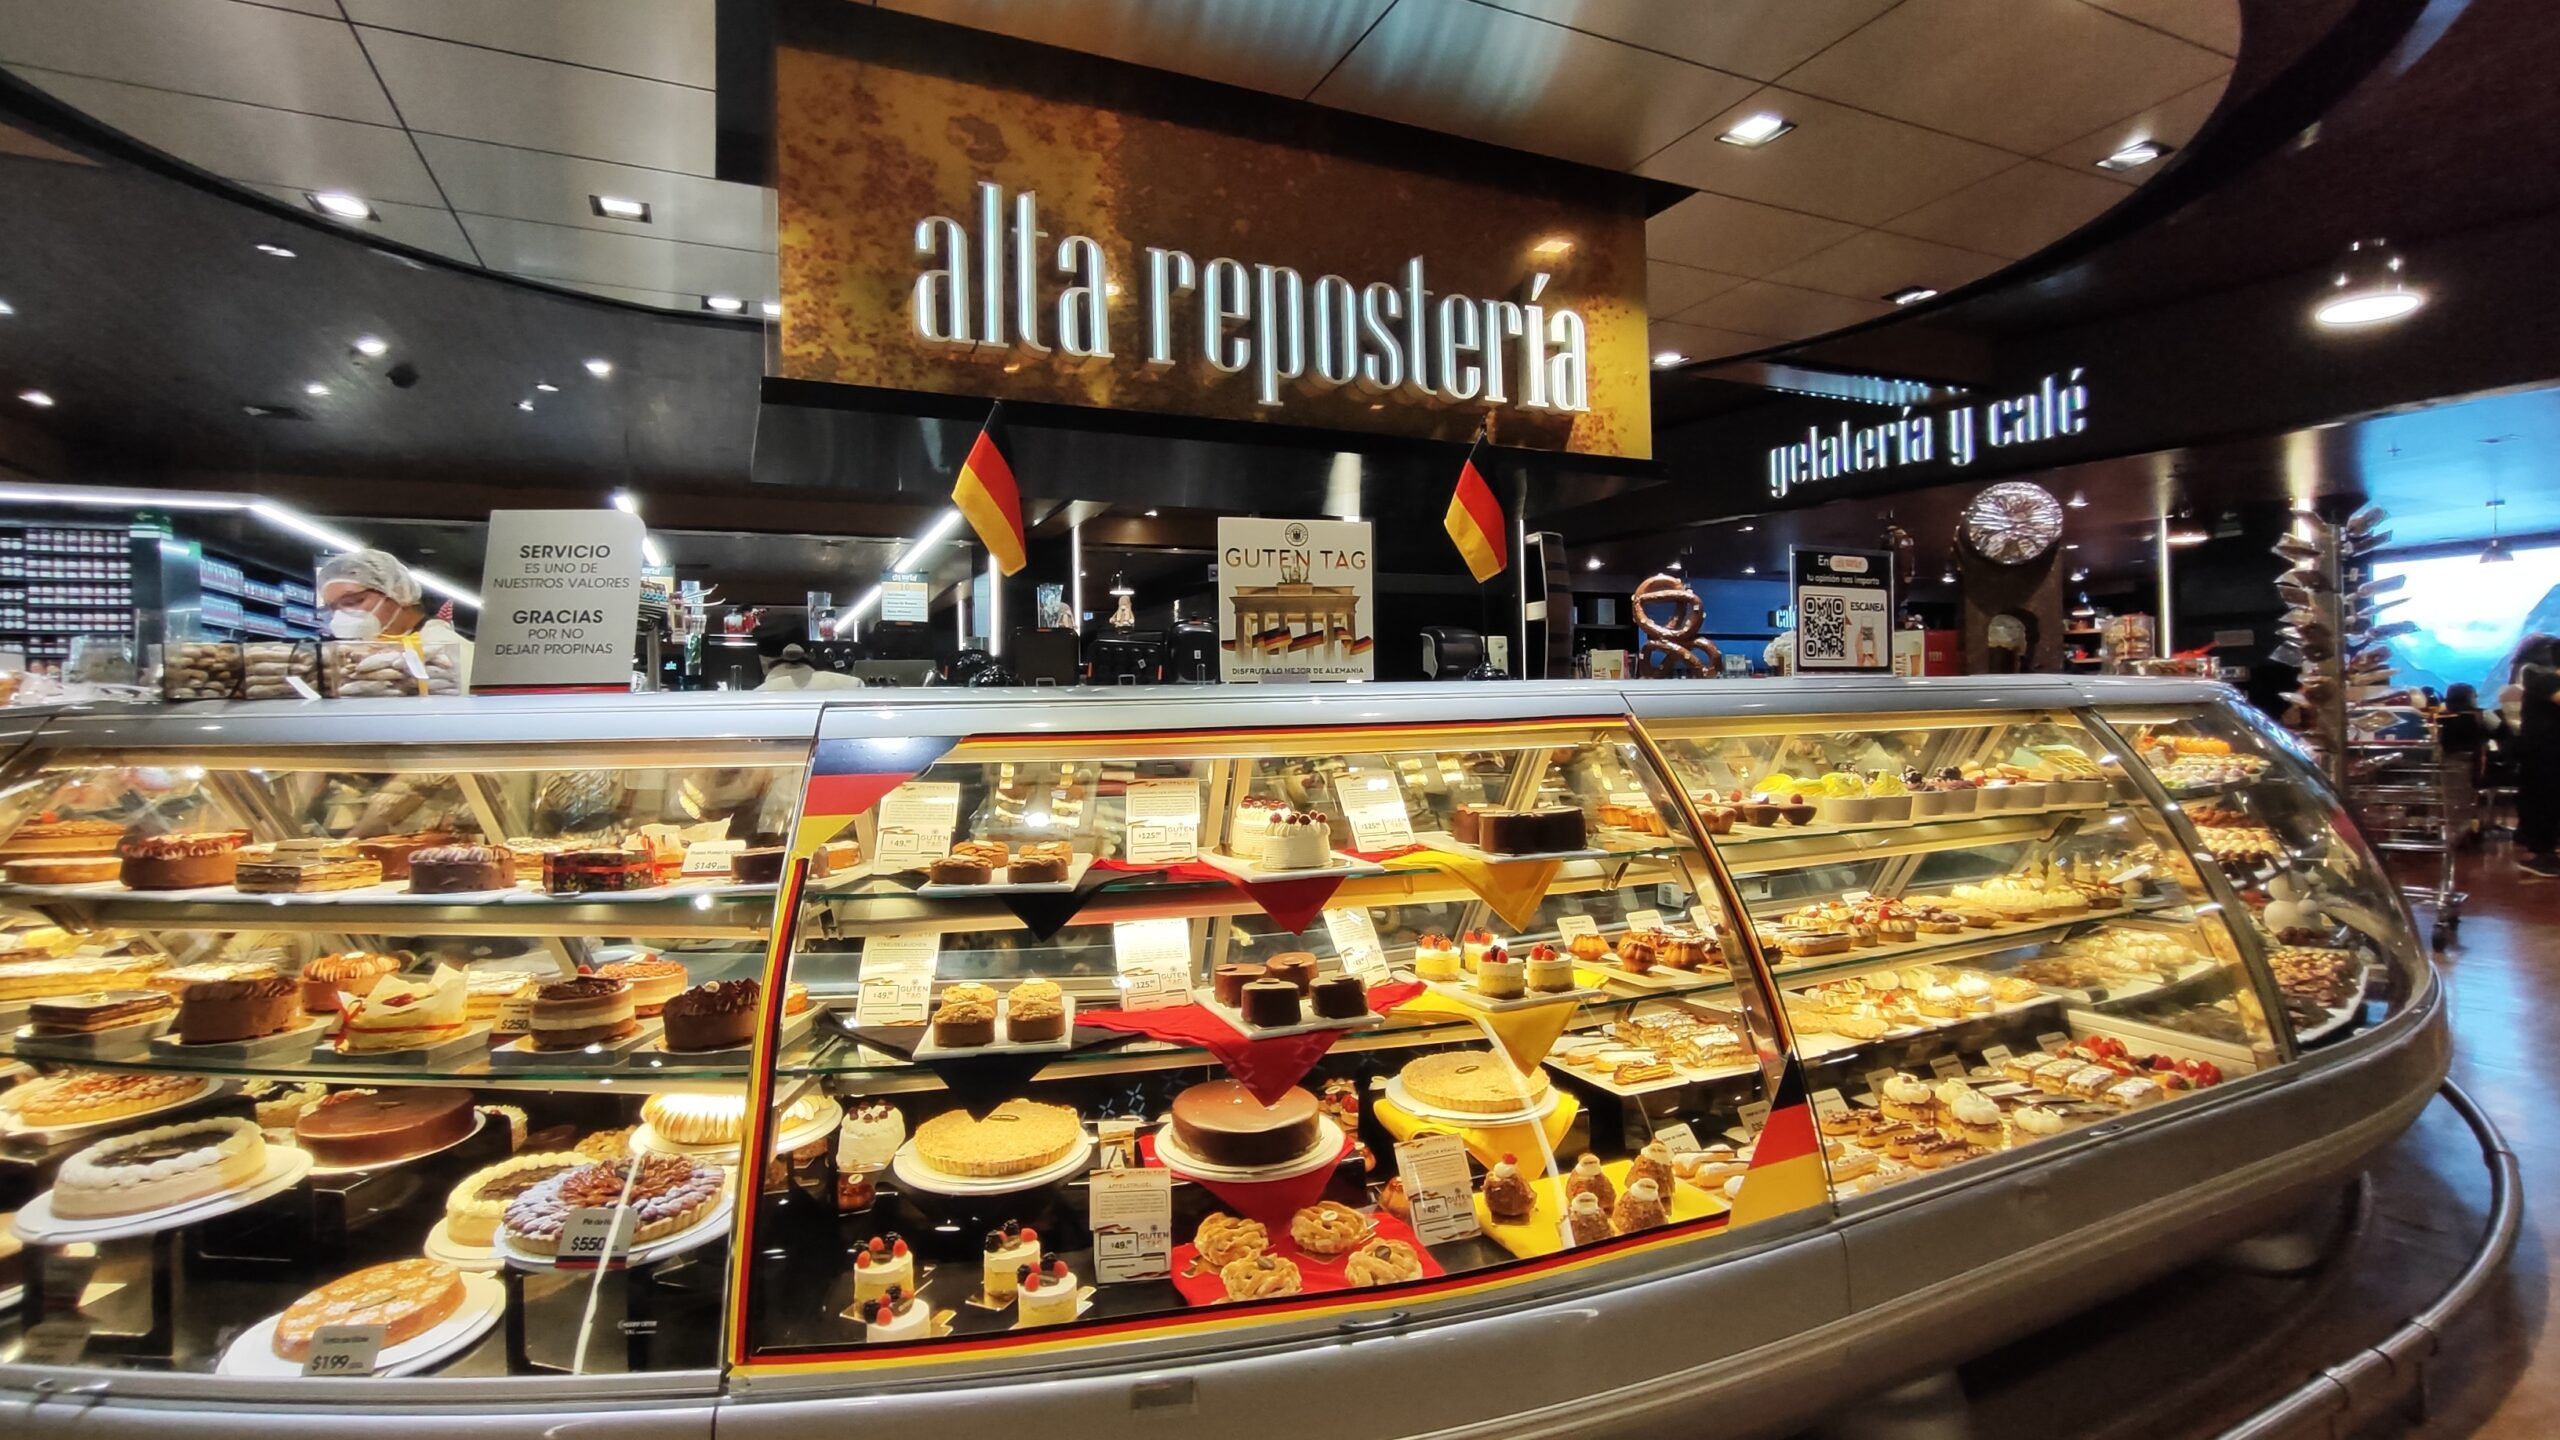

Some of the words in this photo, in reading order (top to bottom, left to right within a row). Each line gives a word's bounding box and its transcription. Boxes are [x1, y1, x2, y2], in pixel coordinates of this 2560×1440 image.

[913, 181, 1115, 360] alta
[1144, 246, 1591, 413] repostería
[1769, 405, 1934, 499] gelatería
[1947, 406, 1976, 467] y
[1987, 367, 2088, 448] café
[519, 545, 611, 559] SERVICIO
[1225, 548, 1311, 569] GUTEN
[1320, 550, 1366, 570] TAG
[1817, 554, 1830, 566] En
[524, 563, 540, 573] ES
[544, 563, 576, 573] UNO
[580, 563, 599, 573] DE
[493, 577, 564, 589] NUESTROS
[568, 577, 630, 588] VALORES
[1850, 601, 1885, 612] ESCANEA
[512, 610, 604, 624] GRACIAS
[528, 629, 557, 639] POR
[561, 629, 584, 639] NO
[495, 644, 540, 656] DEJAR
[543, 643, 613, 655] PROPINAS
[1232, 667, 1270, 675] DISFRUTA
[1271, 667, 1283, 675] LO
[1284, 667, 1311, 675] MEJOR
[1325, 667, 1364, 675] ALEMANIA
[1161, 971, 1188, 980] GUTEN
[900, 985, 929, 993] GUTEN
[1139, 1231, 1170, 1240] GUTEN
